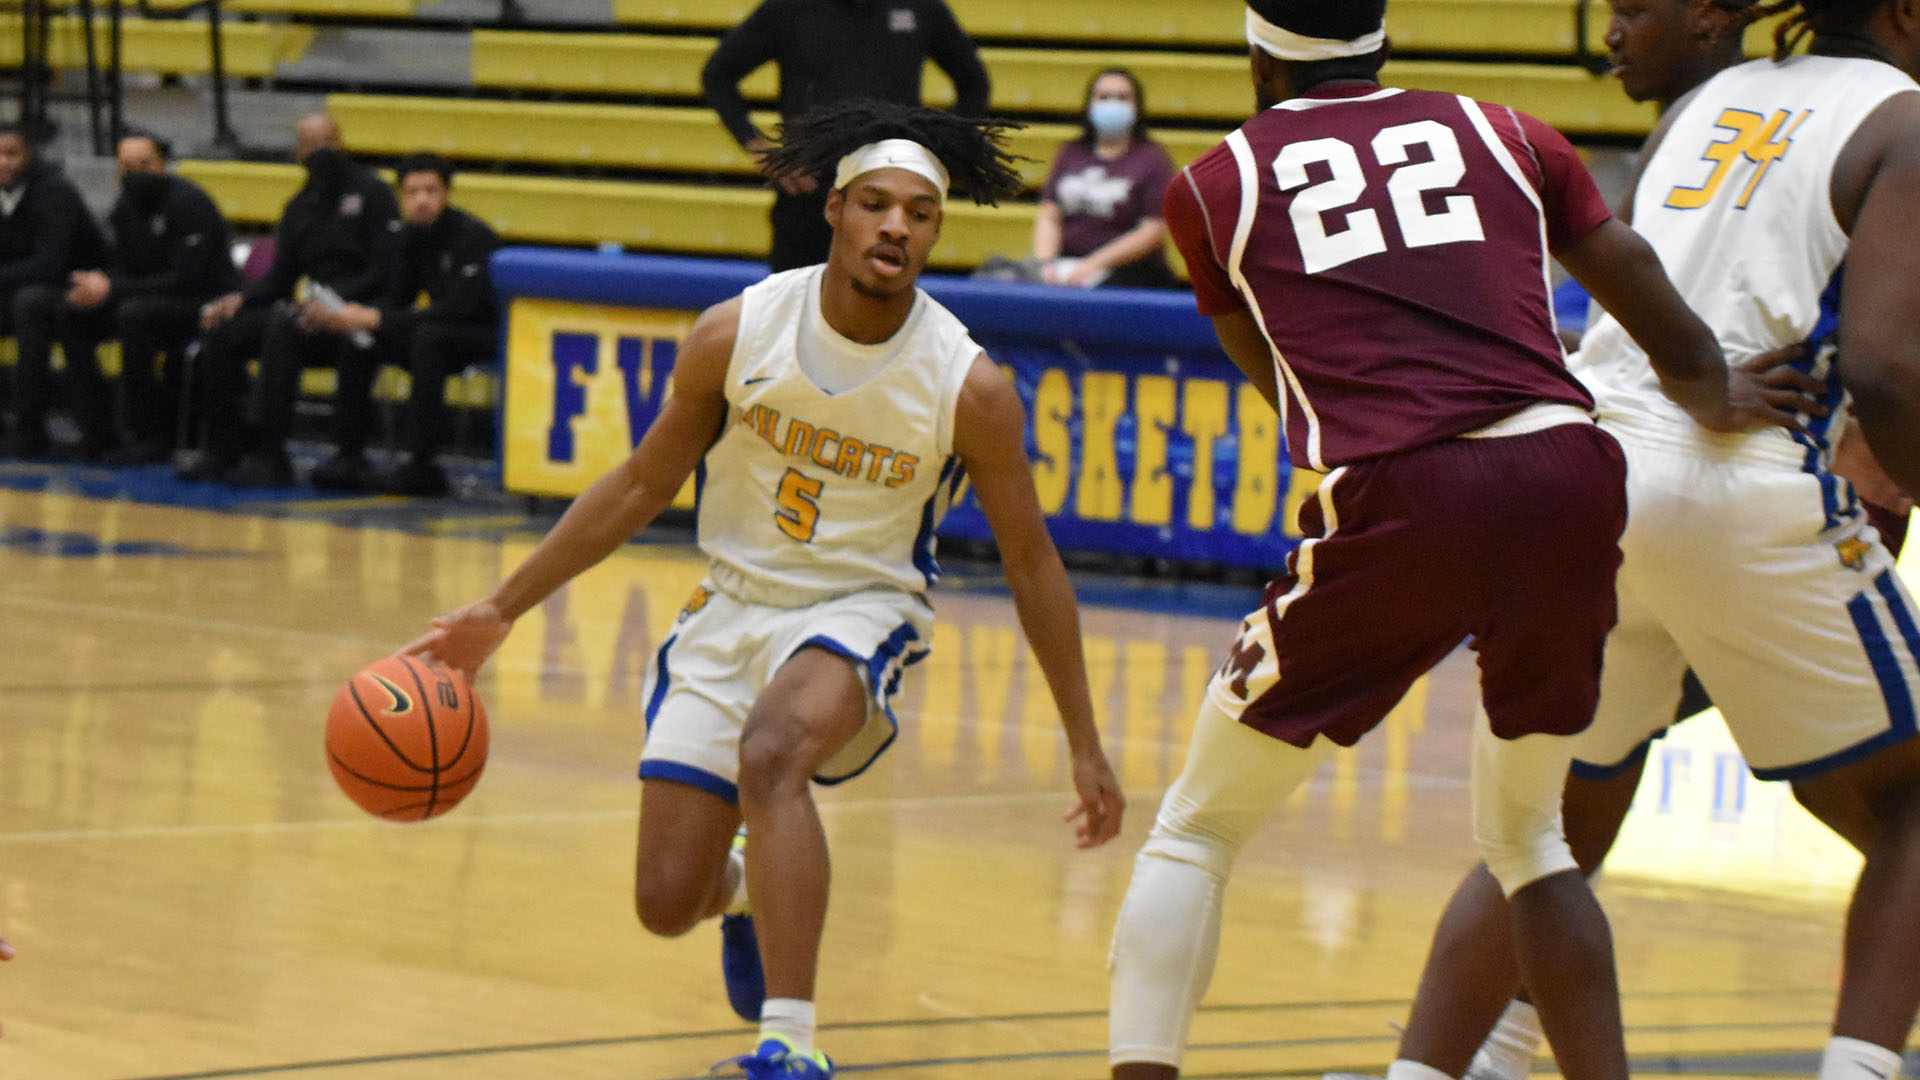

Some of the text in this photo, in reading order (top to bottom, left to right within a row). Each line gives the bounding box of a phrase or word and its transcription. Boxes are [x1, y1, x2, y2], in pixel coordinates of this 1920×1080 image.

[1272, 119, 1486, 275] 22
[1662, 107, 1814, 210] 34
[775, 467, 824, 544] 5
[1000, 364, 1324, 538] SKETB
